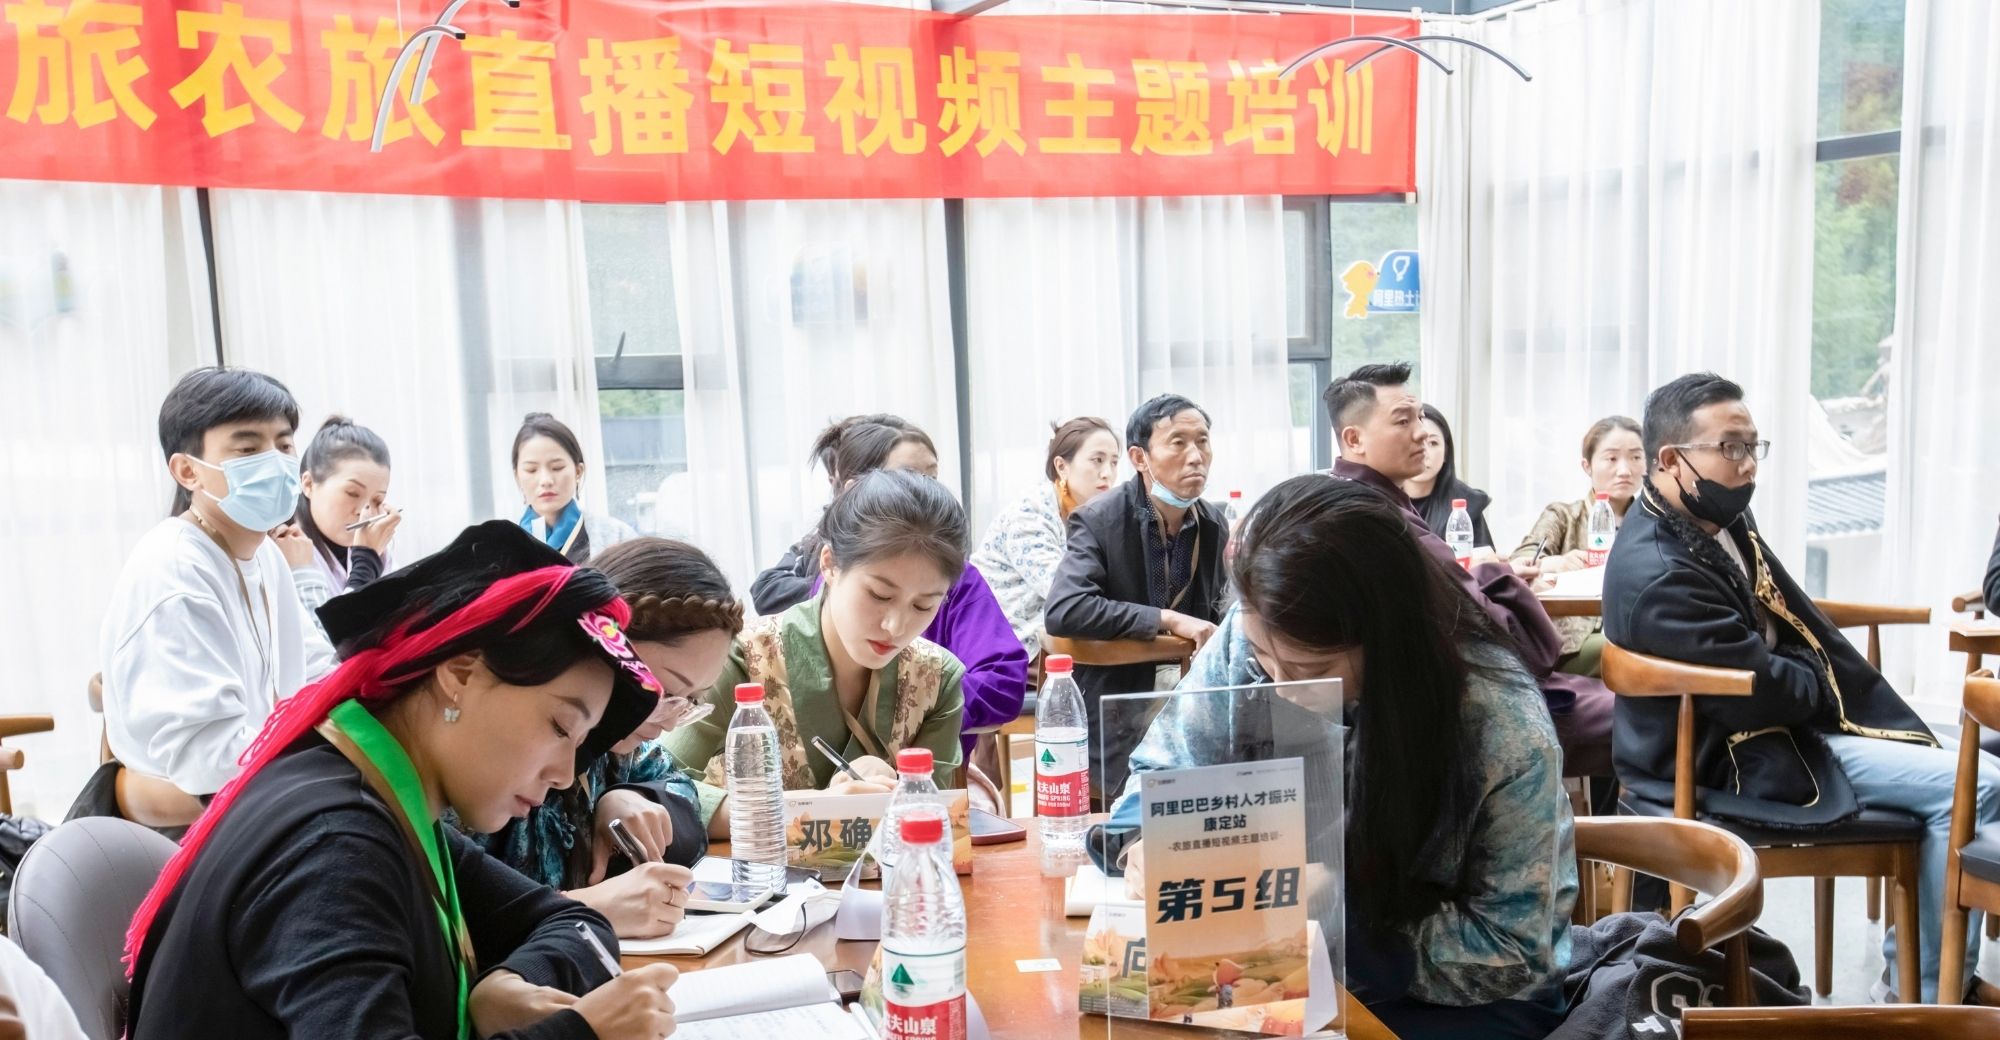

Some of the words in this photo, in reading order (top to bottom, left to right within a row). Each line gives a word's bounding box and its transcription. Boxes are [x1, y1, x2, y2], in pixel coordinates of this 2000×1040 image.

[3, 0, 1375, 158] 旅农旅直播短视频主题培训
[1150, 788, 1297, 818] 阿里巴巴乡村人才振兴
[1203, 814, 1247, 832] 康定站
[1155, 867, 1300, 924] 第5组
